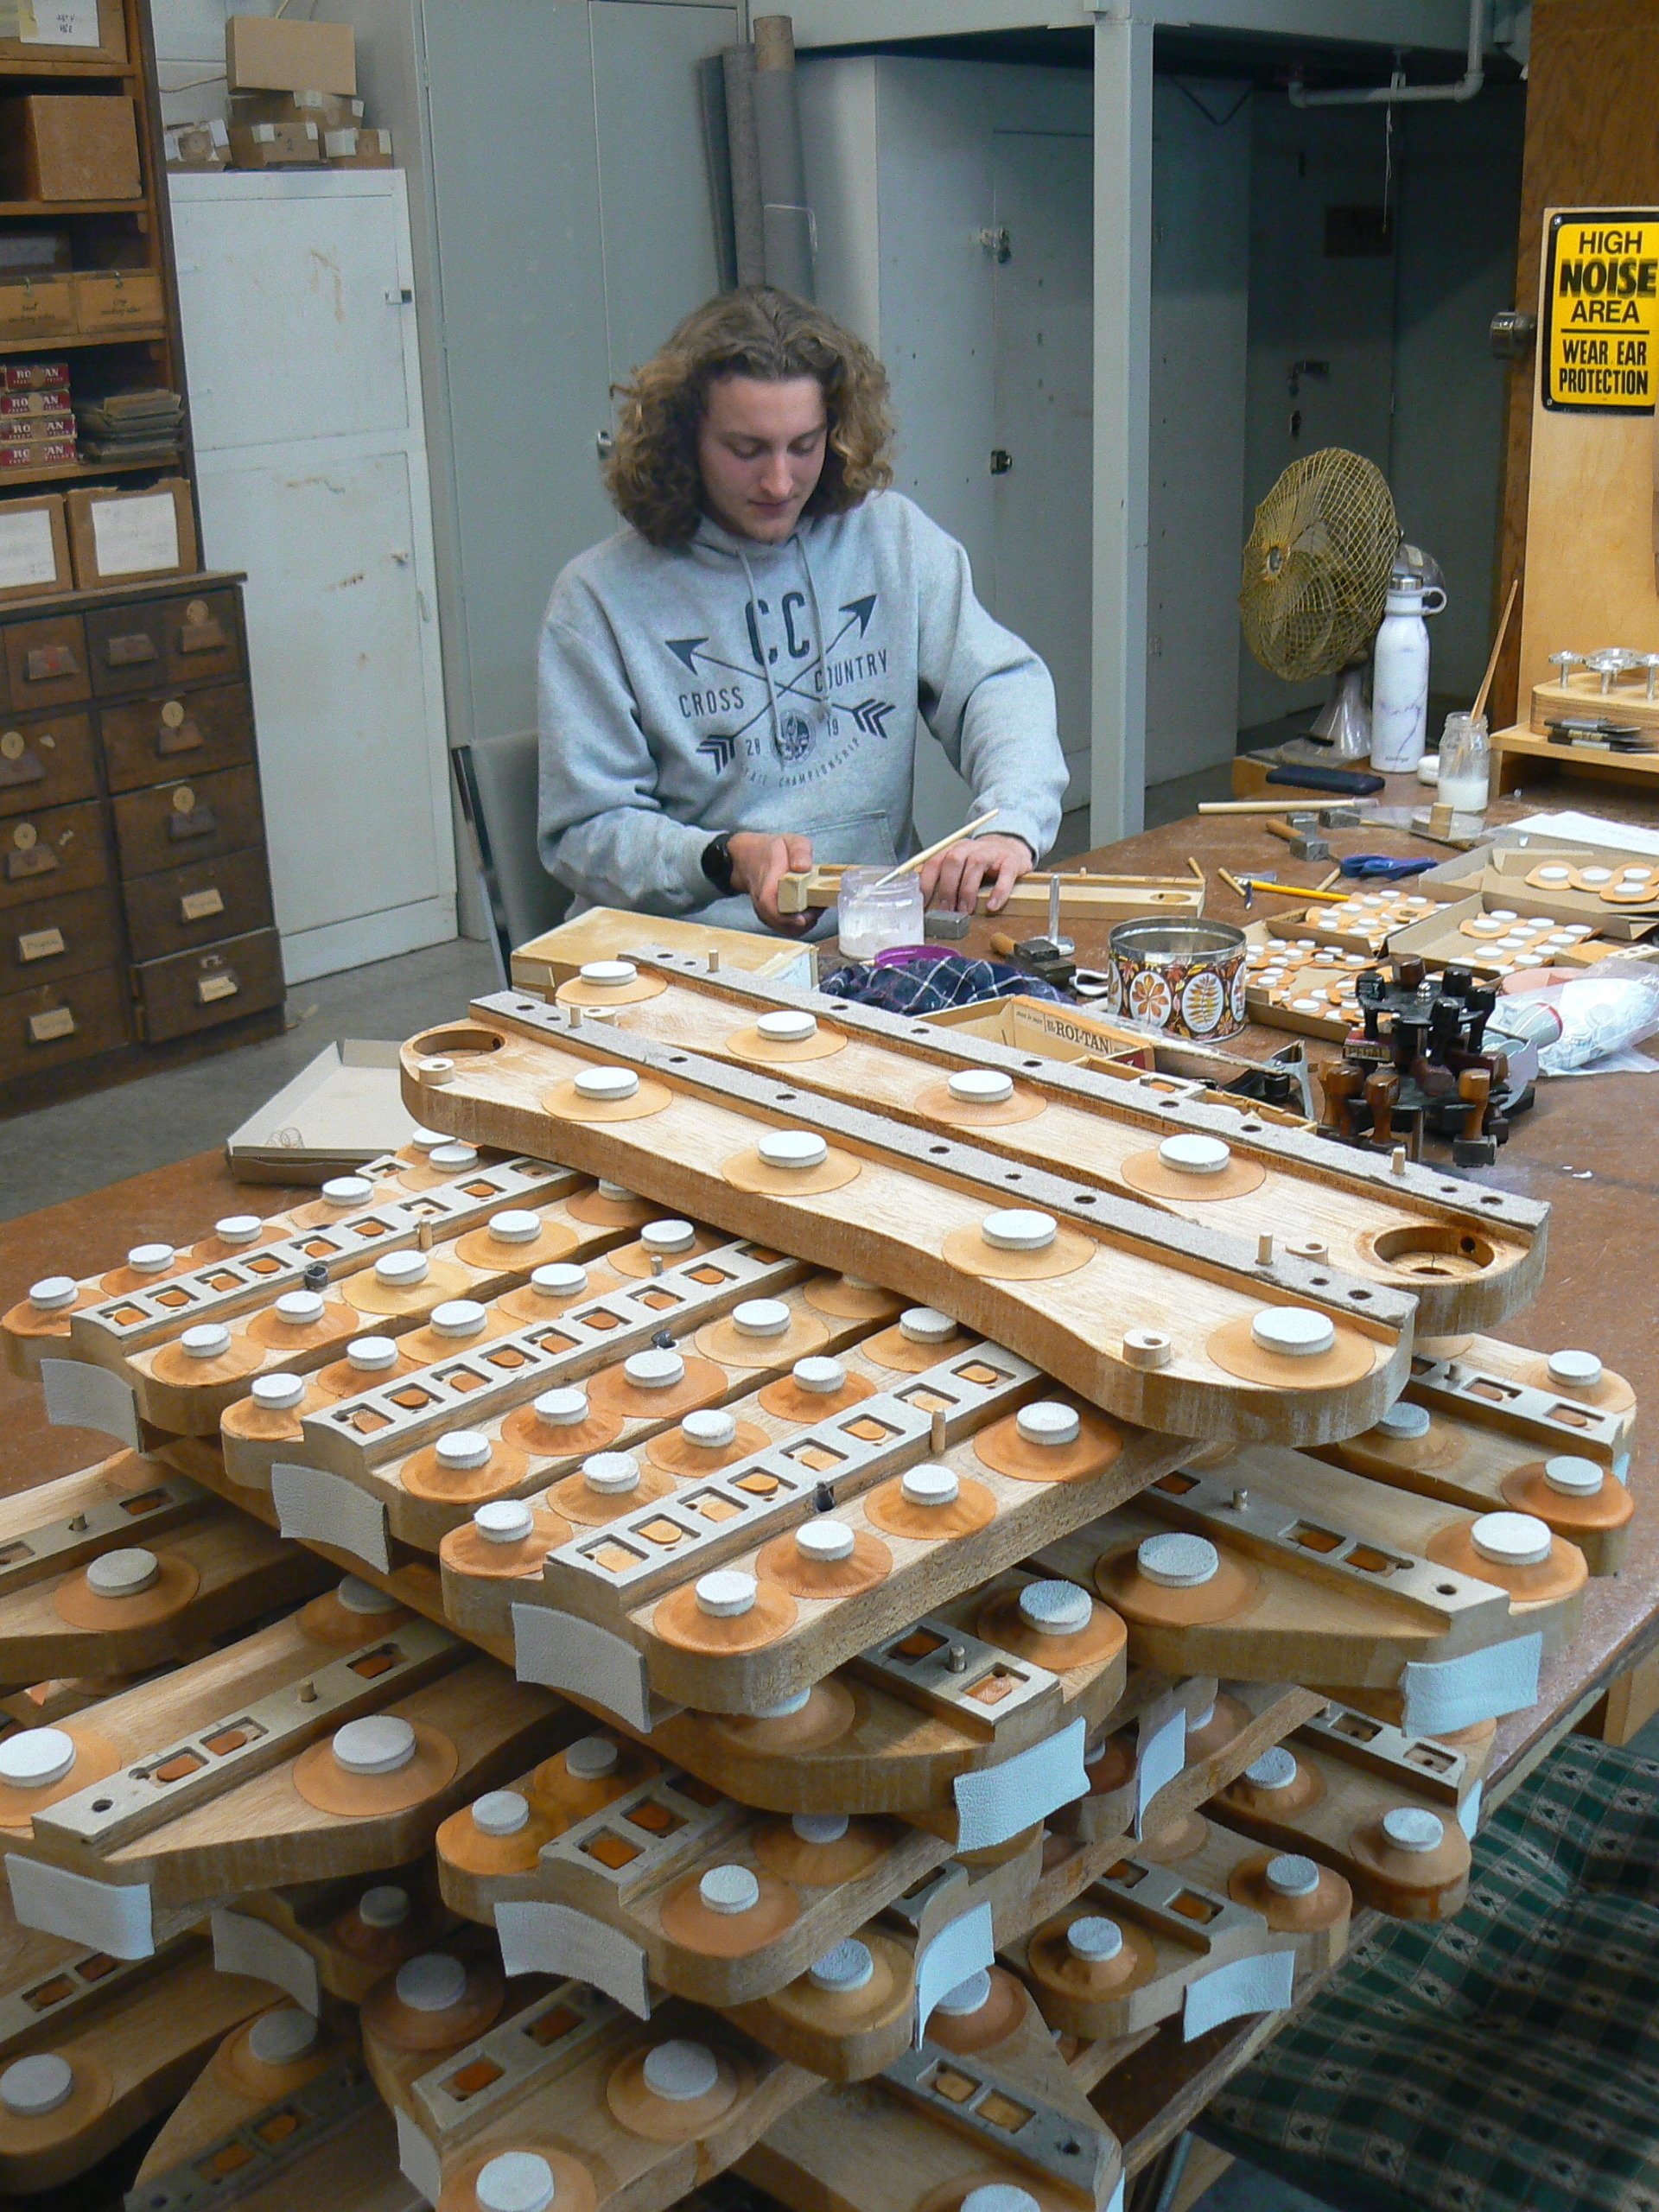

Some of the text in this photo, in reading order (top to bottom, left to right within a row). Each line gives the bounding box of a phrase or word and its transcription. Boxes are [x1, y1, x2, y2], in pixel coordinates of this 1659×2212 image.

[1579, 230, 1643, 255] HIGH
[1559, 258, 1658, 298] NOISE
[1570, 300, 1641, 323] AREA
[1562, 339, 1648, 366] WEAR EAR
[1559, 369, 1649, 396] PROTECTION
[745, 592, 810, 666] CC
[678, 686, 745, 718] CROSS
[746, 713, 839, 756] 20 19
[1056, 1020, 1110, 1054] ROI-TAN
